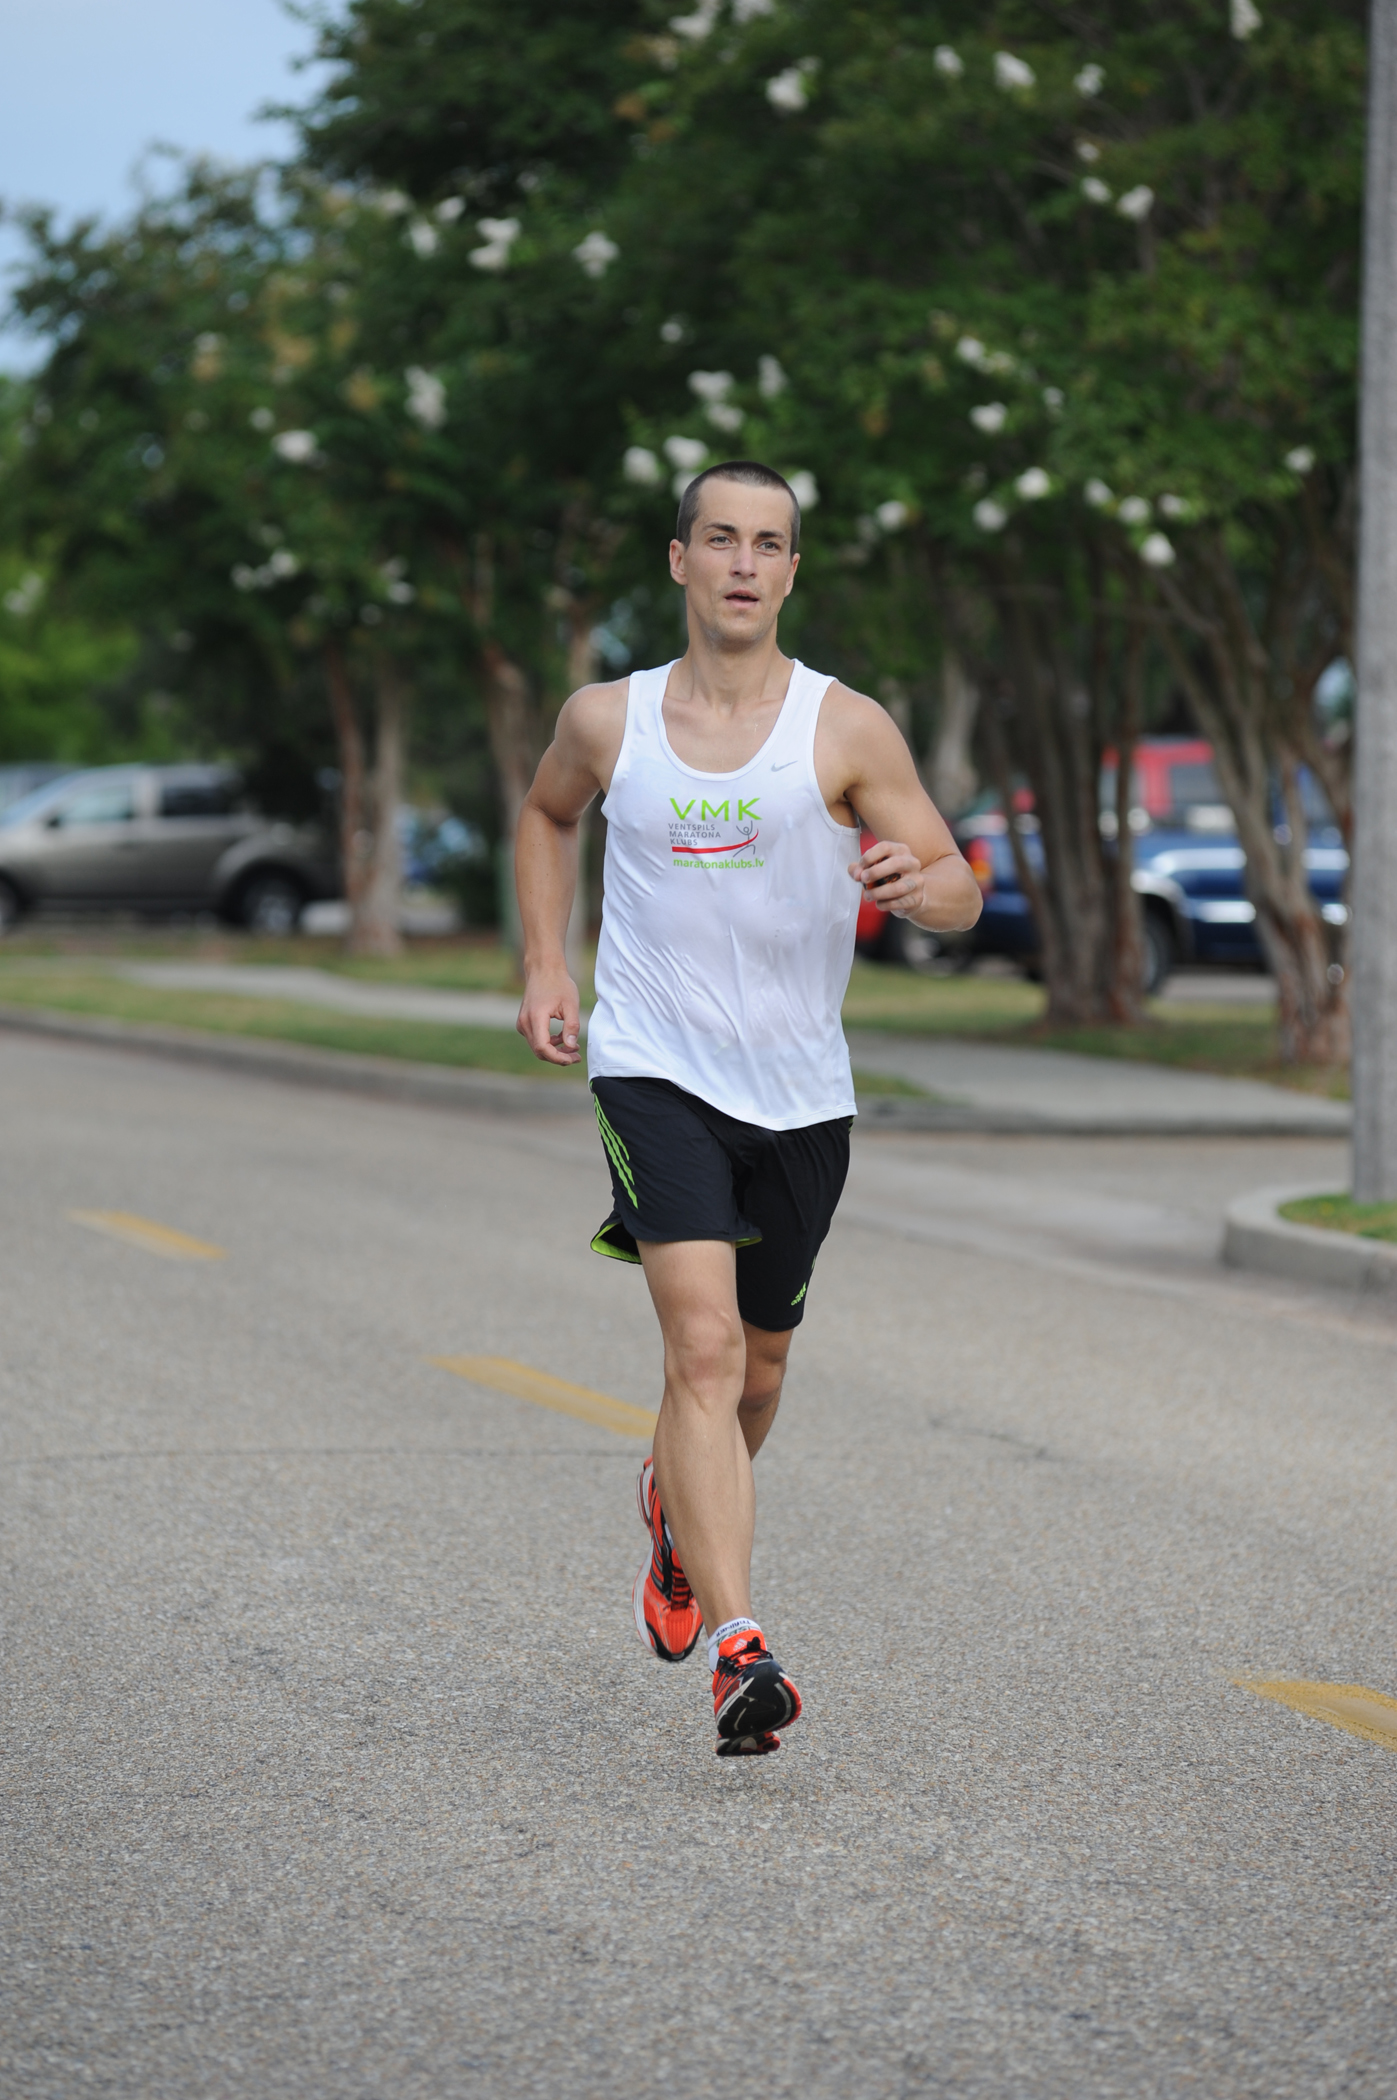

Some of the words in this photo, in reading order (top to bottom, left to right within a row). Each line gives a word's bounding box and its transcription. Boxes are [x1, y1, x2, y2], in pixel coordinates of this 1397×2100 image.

[669, 797, 762, 821] VMK
[668, 823, 716, 831] VENTSPILS
[670, 838, 698, 846] KLUBS
[673, 857, 764, 869] maratonaklubs.lv
